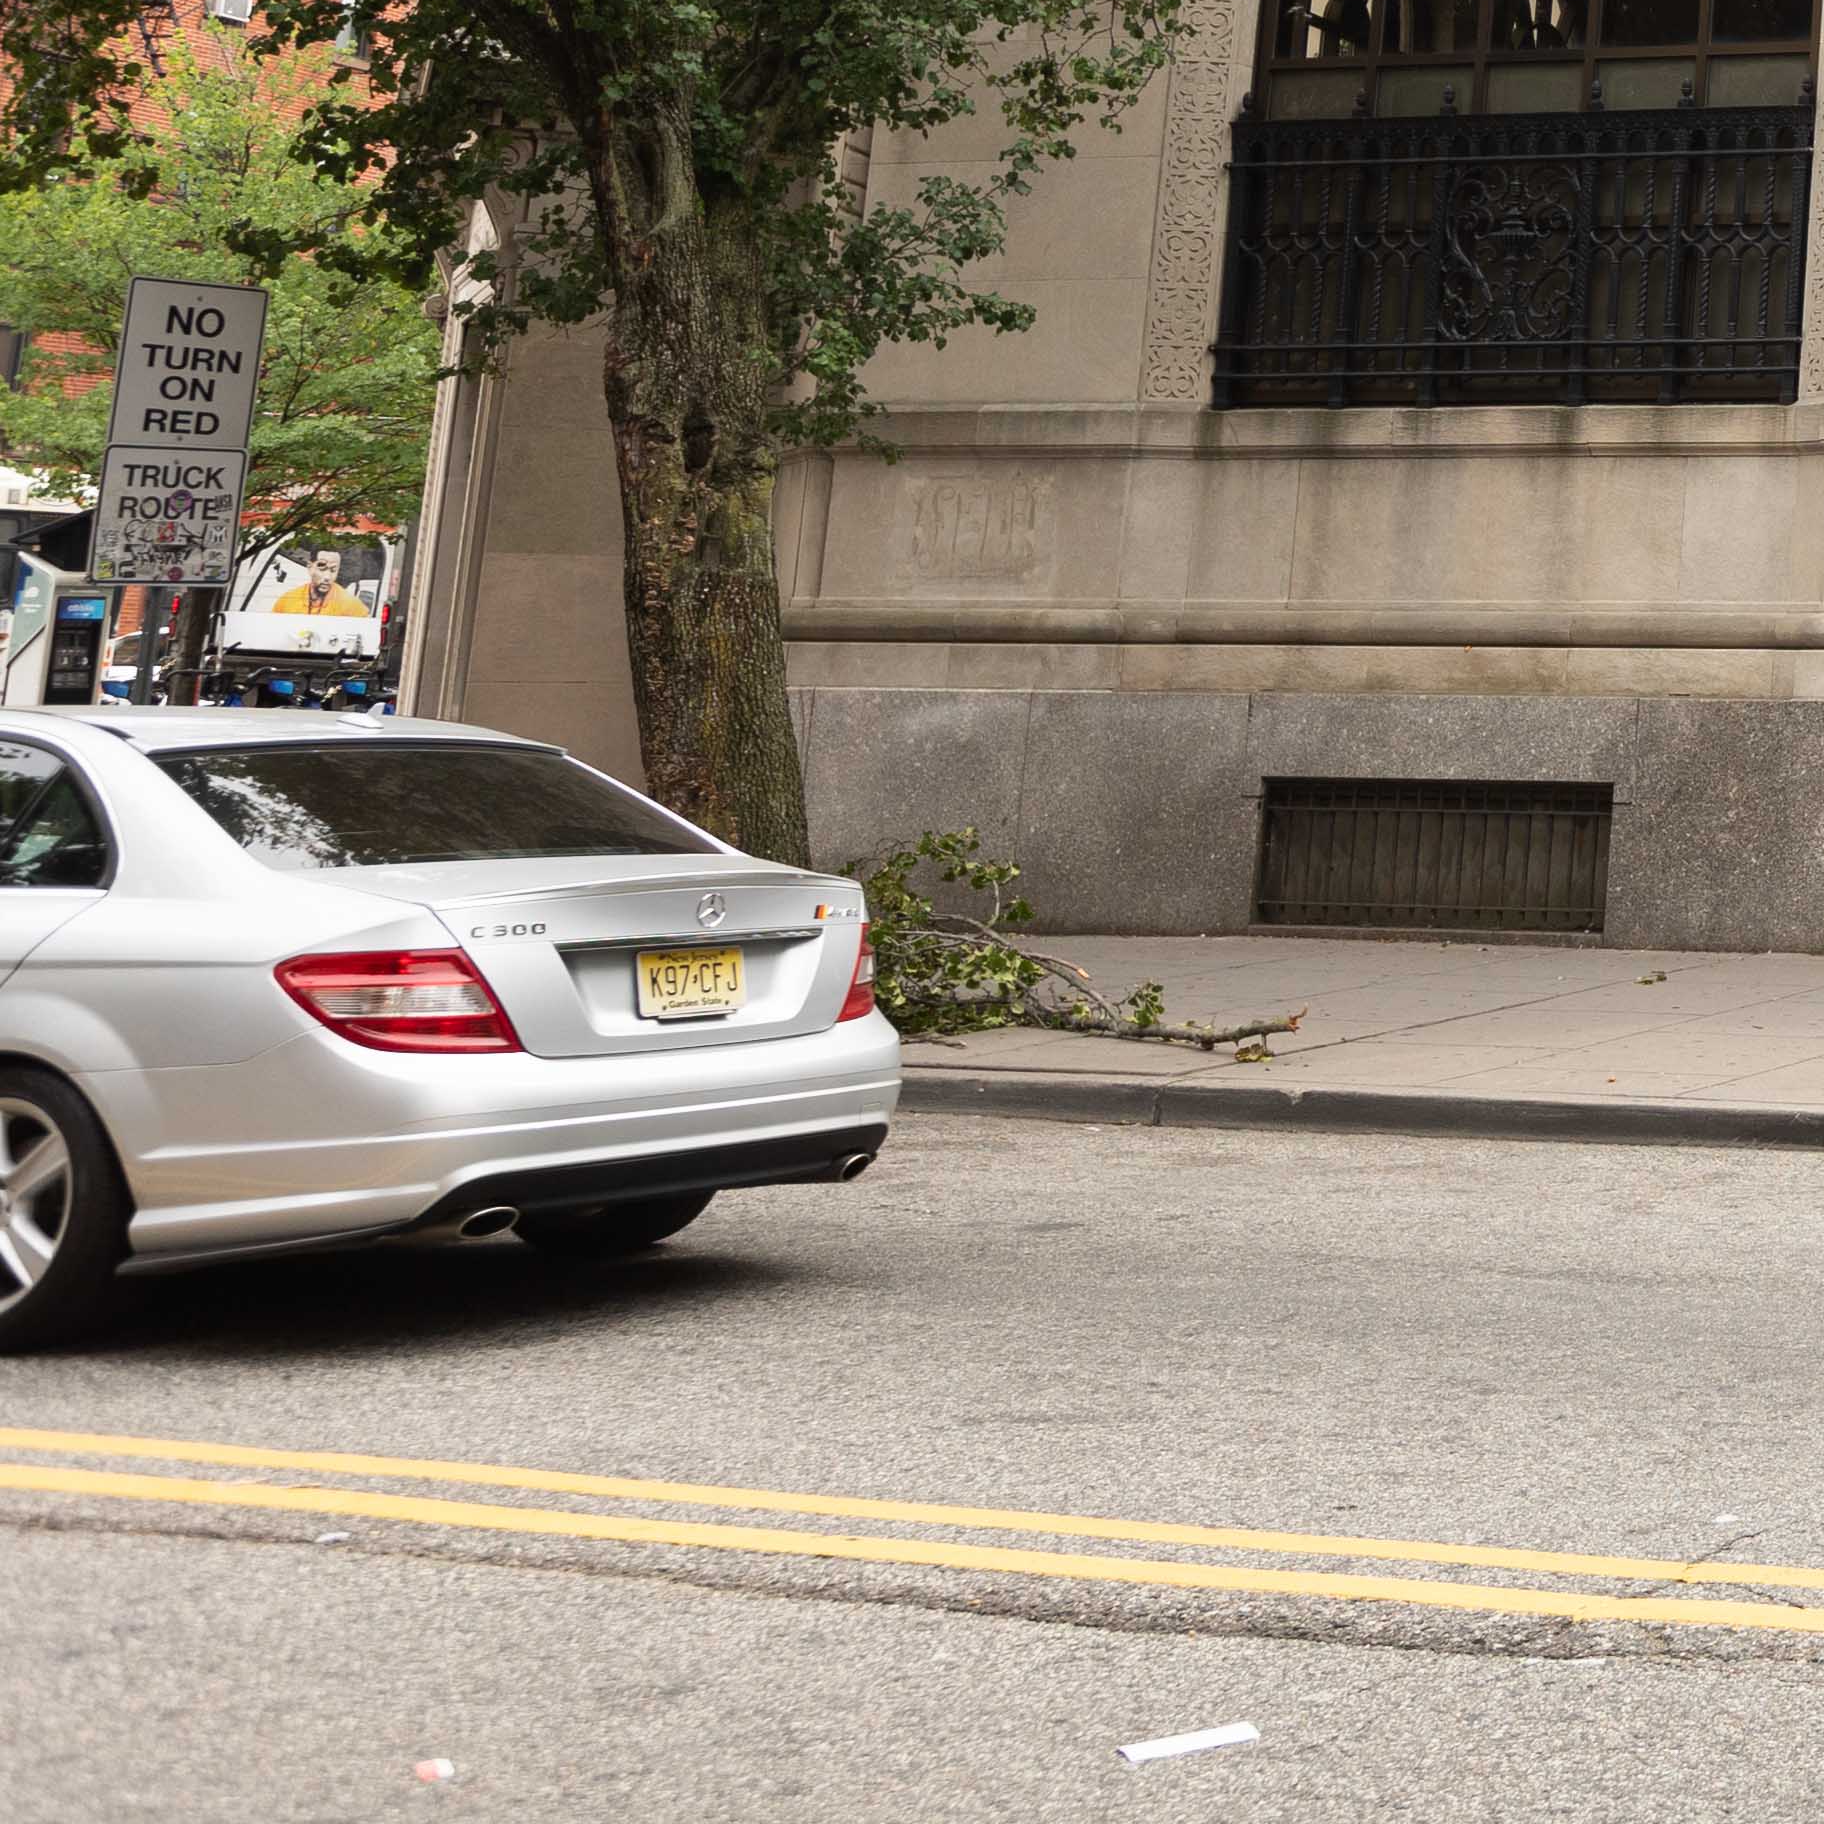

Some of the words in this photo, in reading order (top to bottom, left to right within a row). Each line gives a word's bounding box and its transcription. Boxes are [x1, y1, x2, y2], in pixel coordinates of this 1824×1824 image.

[166, 305, 225, 338] NO
[141, 343, 243, 374] TURN
[159, 376, 215, 402] ON
[142, 408, 220, 436] RED
[122, 464, 225, 490] TRUCK
[117, 495, 219, 521] ROUTE
[470, 926, 486, 938] C
[492, 923, 546, 937] 300
[668, 999, 698, 1009] Garden
